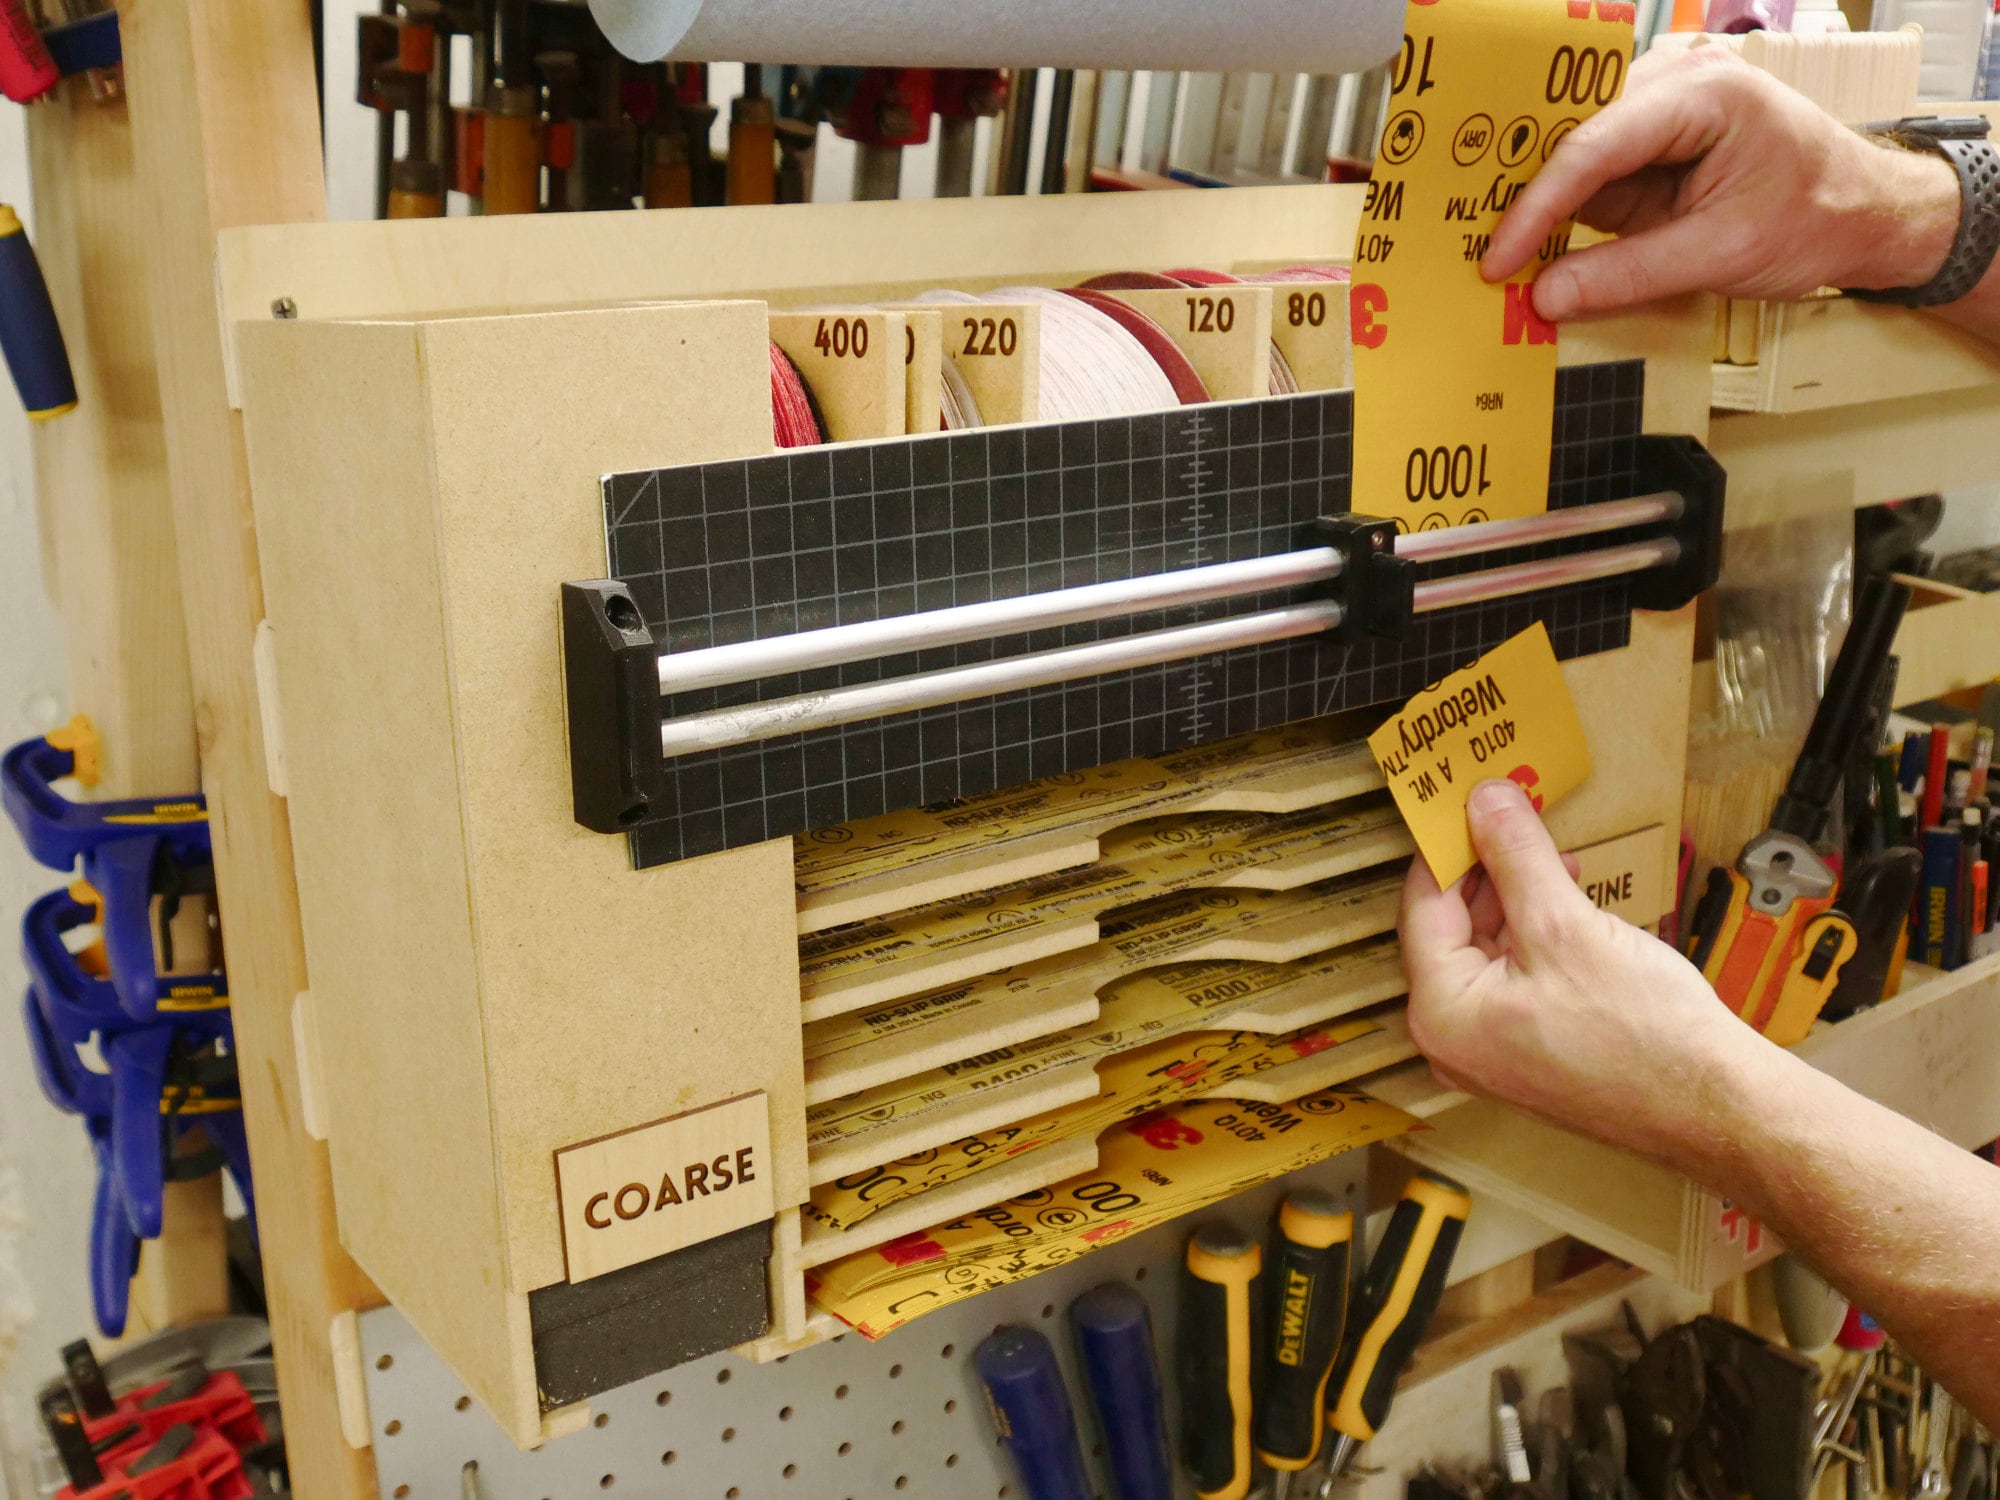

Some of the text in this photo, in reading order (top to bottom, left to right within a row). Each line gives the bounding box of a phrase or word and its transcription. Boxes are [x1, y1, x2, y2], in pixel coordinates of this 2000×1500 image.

[1459, 129, 1487, 149] DRY
[1356, 233, 1395, 263] 401
[1186, 296, 1235, 333] 120
[1287, 291, 1326, 327] 80
[814, 317, 868, 359] 400
[962, 317, 1017, 357] 220
[1405, 442, 1491, 503] 1000
[1468, 718, 1516, 763] 401Q
[1408, 756, 1454, 803] A Wt.
[1185, 979, 1252, 1009] P400
[864, 1001, 929, 1027] NO-SLIP
[919, 1090, 947, 1104] NG
[1213, 1113, 1267, 1143] 401Q
[584, 1146, 756, 1230] COARSE
[1278, 1268, 1312, 1368] DEWALT
